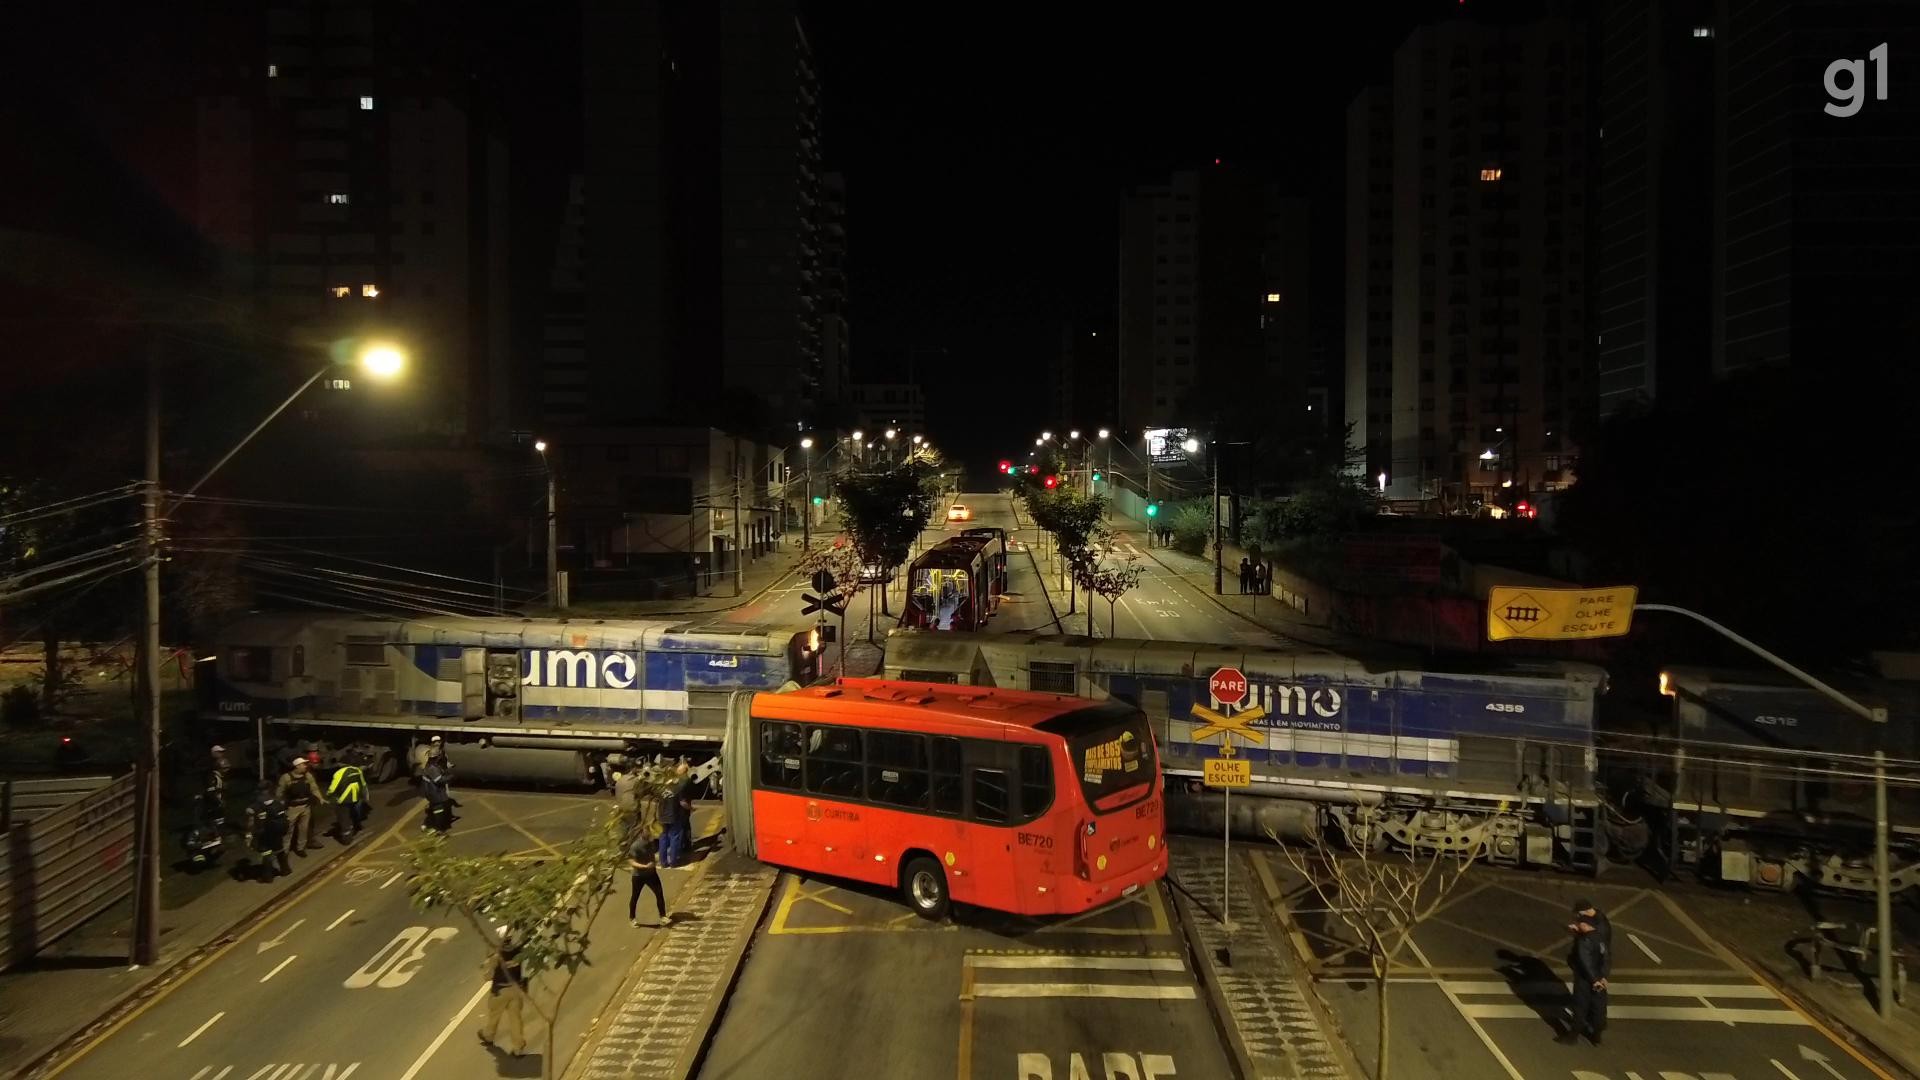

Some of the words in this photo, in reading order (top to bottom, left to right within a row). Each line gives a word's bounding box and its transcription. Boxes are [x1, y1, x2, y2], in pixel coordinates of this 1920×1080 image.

[1580, 596, 1615, 605] PARE
[1576, 609, 1612, 619] OLHE
[1562, 622, 1616, 633] ESCUTE
[521, 650, 636, 689] umo
[1212, 681, 1244, 692] PARE
[1485, 703, 1524, 713] 4359
[1214, 762, 1240, 773] OLHE
[1208, 774, 1246, 785] ESCUTE
[1018, 832, 1053, 849] BE720
